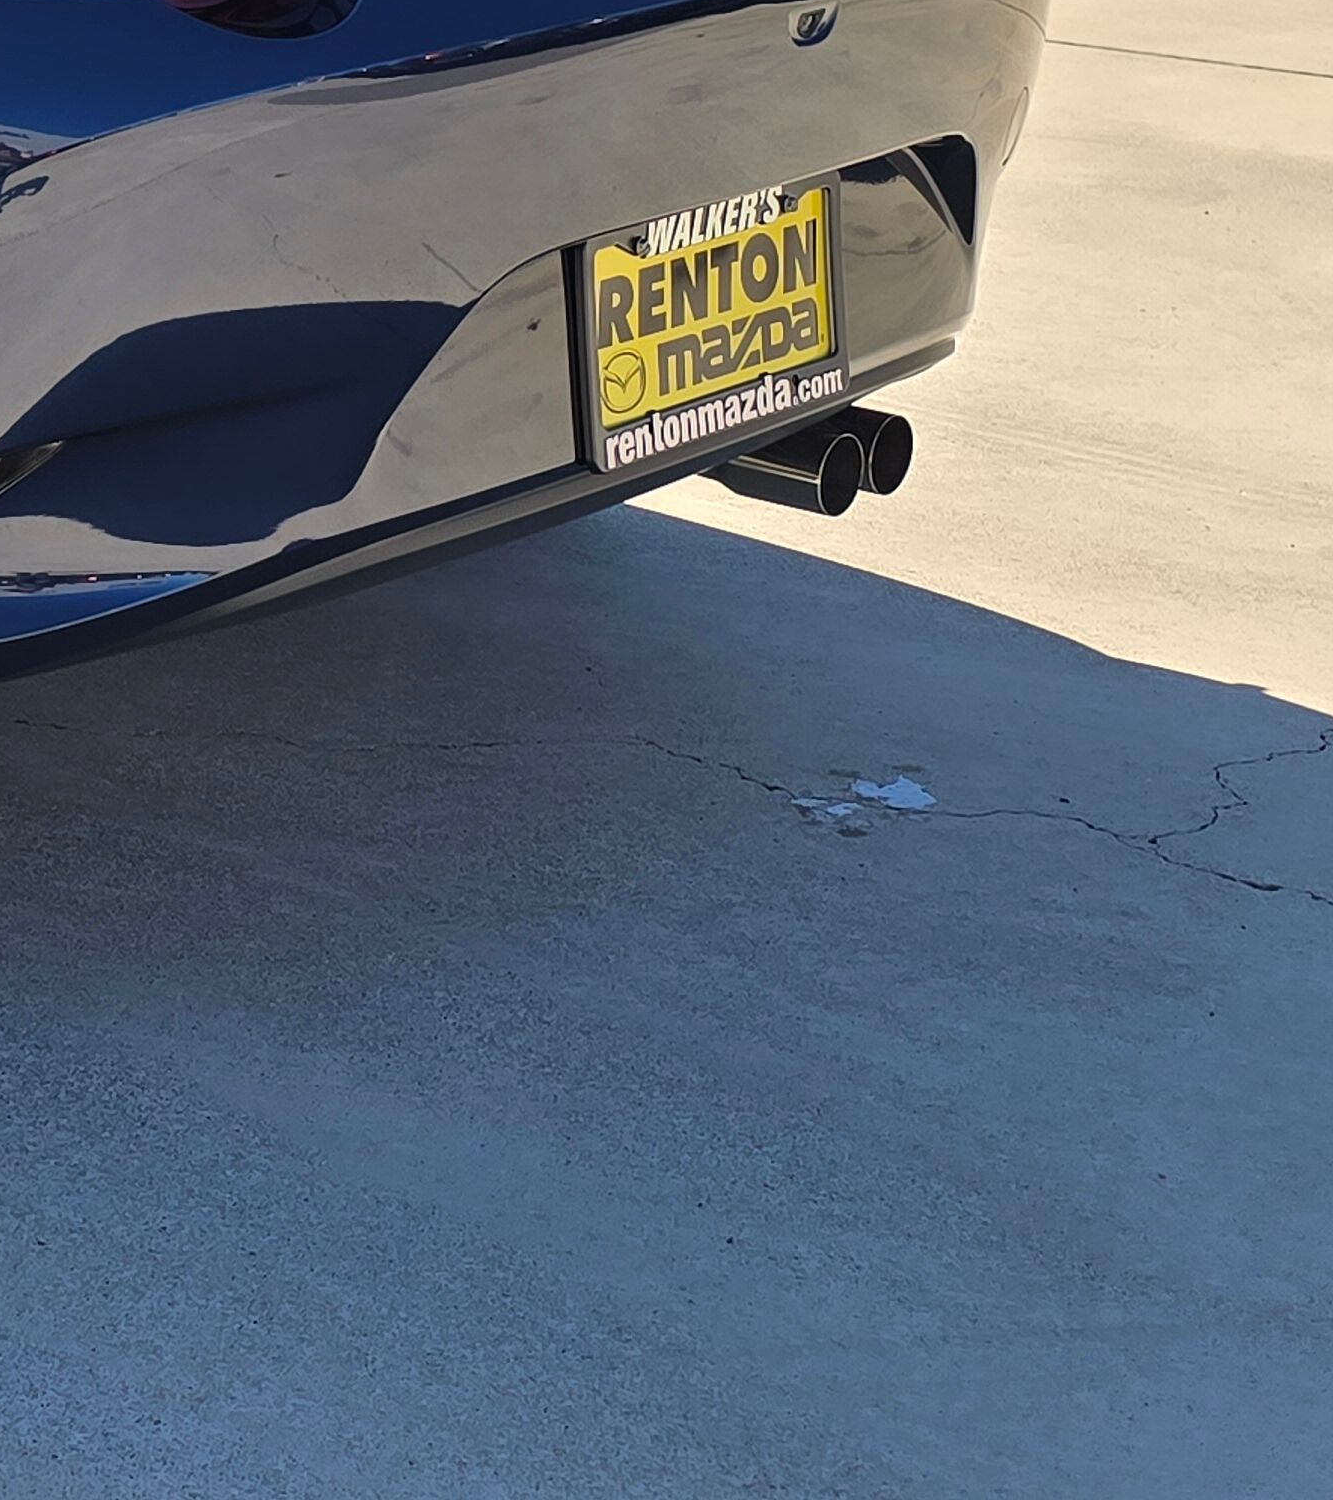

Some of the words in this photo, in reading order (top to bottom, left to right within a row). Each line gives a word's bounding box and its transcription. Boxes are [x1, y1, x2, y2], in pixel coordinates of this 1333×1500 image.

[646, 185, 783, 258] WALKER'S
[597, 218, 817, 348] RENTON
[605, 368, 844, 470] rentonmazda.com
